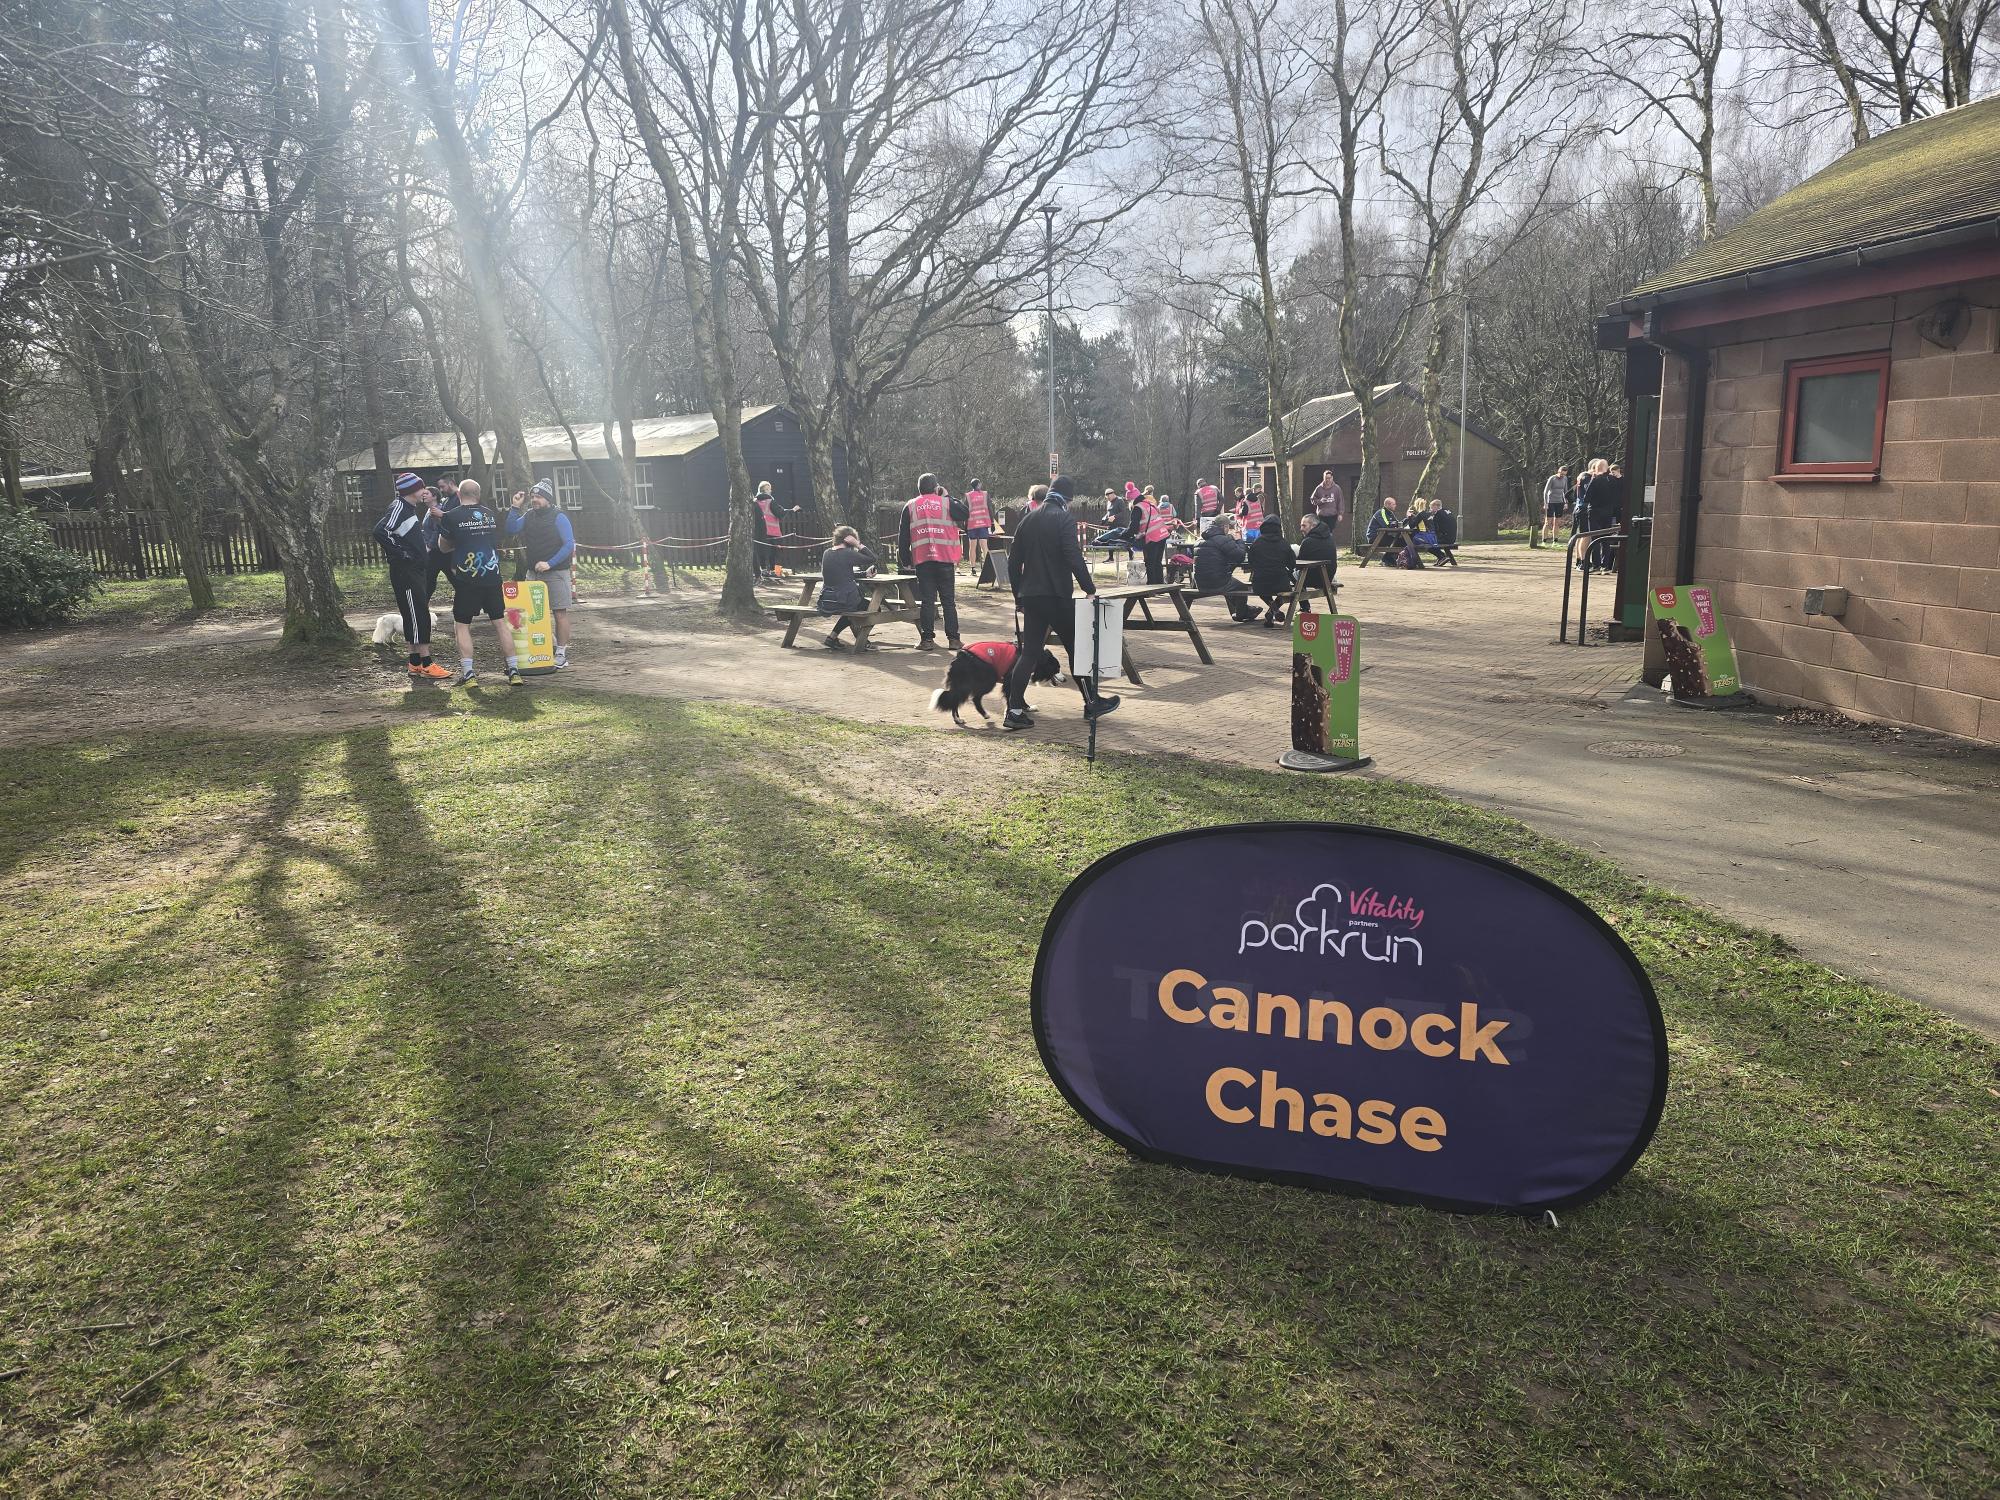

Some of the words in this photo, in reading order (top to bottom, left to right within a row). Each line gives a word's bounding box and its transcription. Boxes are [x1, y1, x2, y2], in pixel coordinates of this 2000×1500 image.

[916, 527, 945, 535] VONTEER
[1339, 628, 1350, 637] YOU
[1337, 637, 1352, 645] WANT
[1340, 646, 1349, 654] ME
[1332, 739, 1355, 748] FEAST
[1349, 887, 1425, 930] Vitality
[1238, 884, 1422, 965] parkrun
[1348, 919, 1379, 928] partners
[1158, 968, 1511, 1066] Cannock
[1205, 1066, 1448, 1152] Chase
